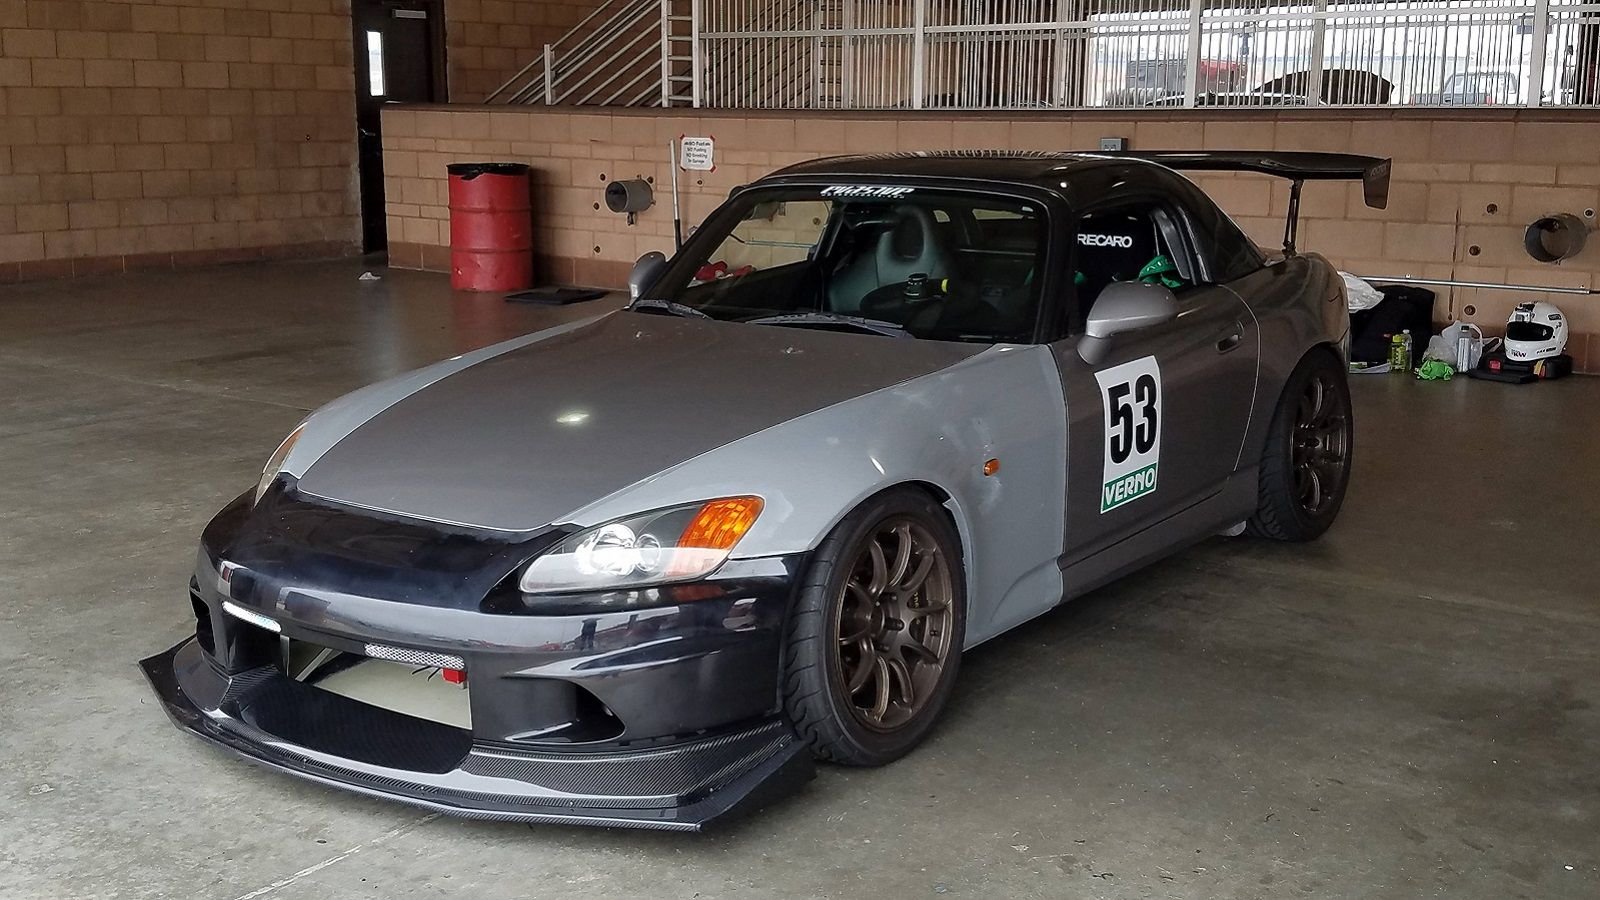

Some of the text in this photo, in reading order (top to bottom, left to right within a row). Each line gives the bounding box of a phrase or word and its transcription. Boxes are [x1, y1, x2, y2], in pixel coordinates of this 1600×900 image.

[1077, 233, 1133, 248] RECARO
[1107, 373, 1158, 465] 53
[1105, 467, 1156, 506] VERNO
